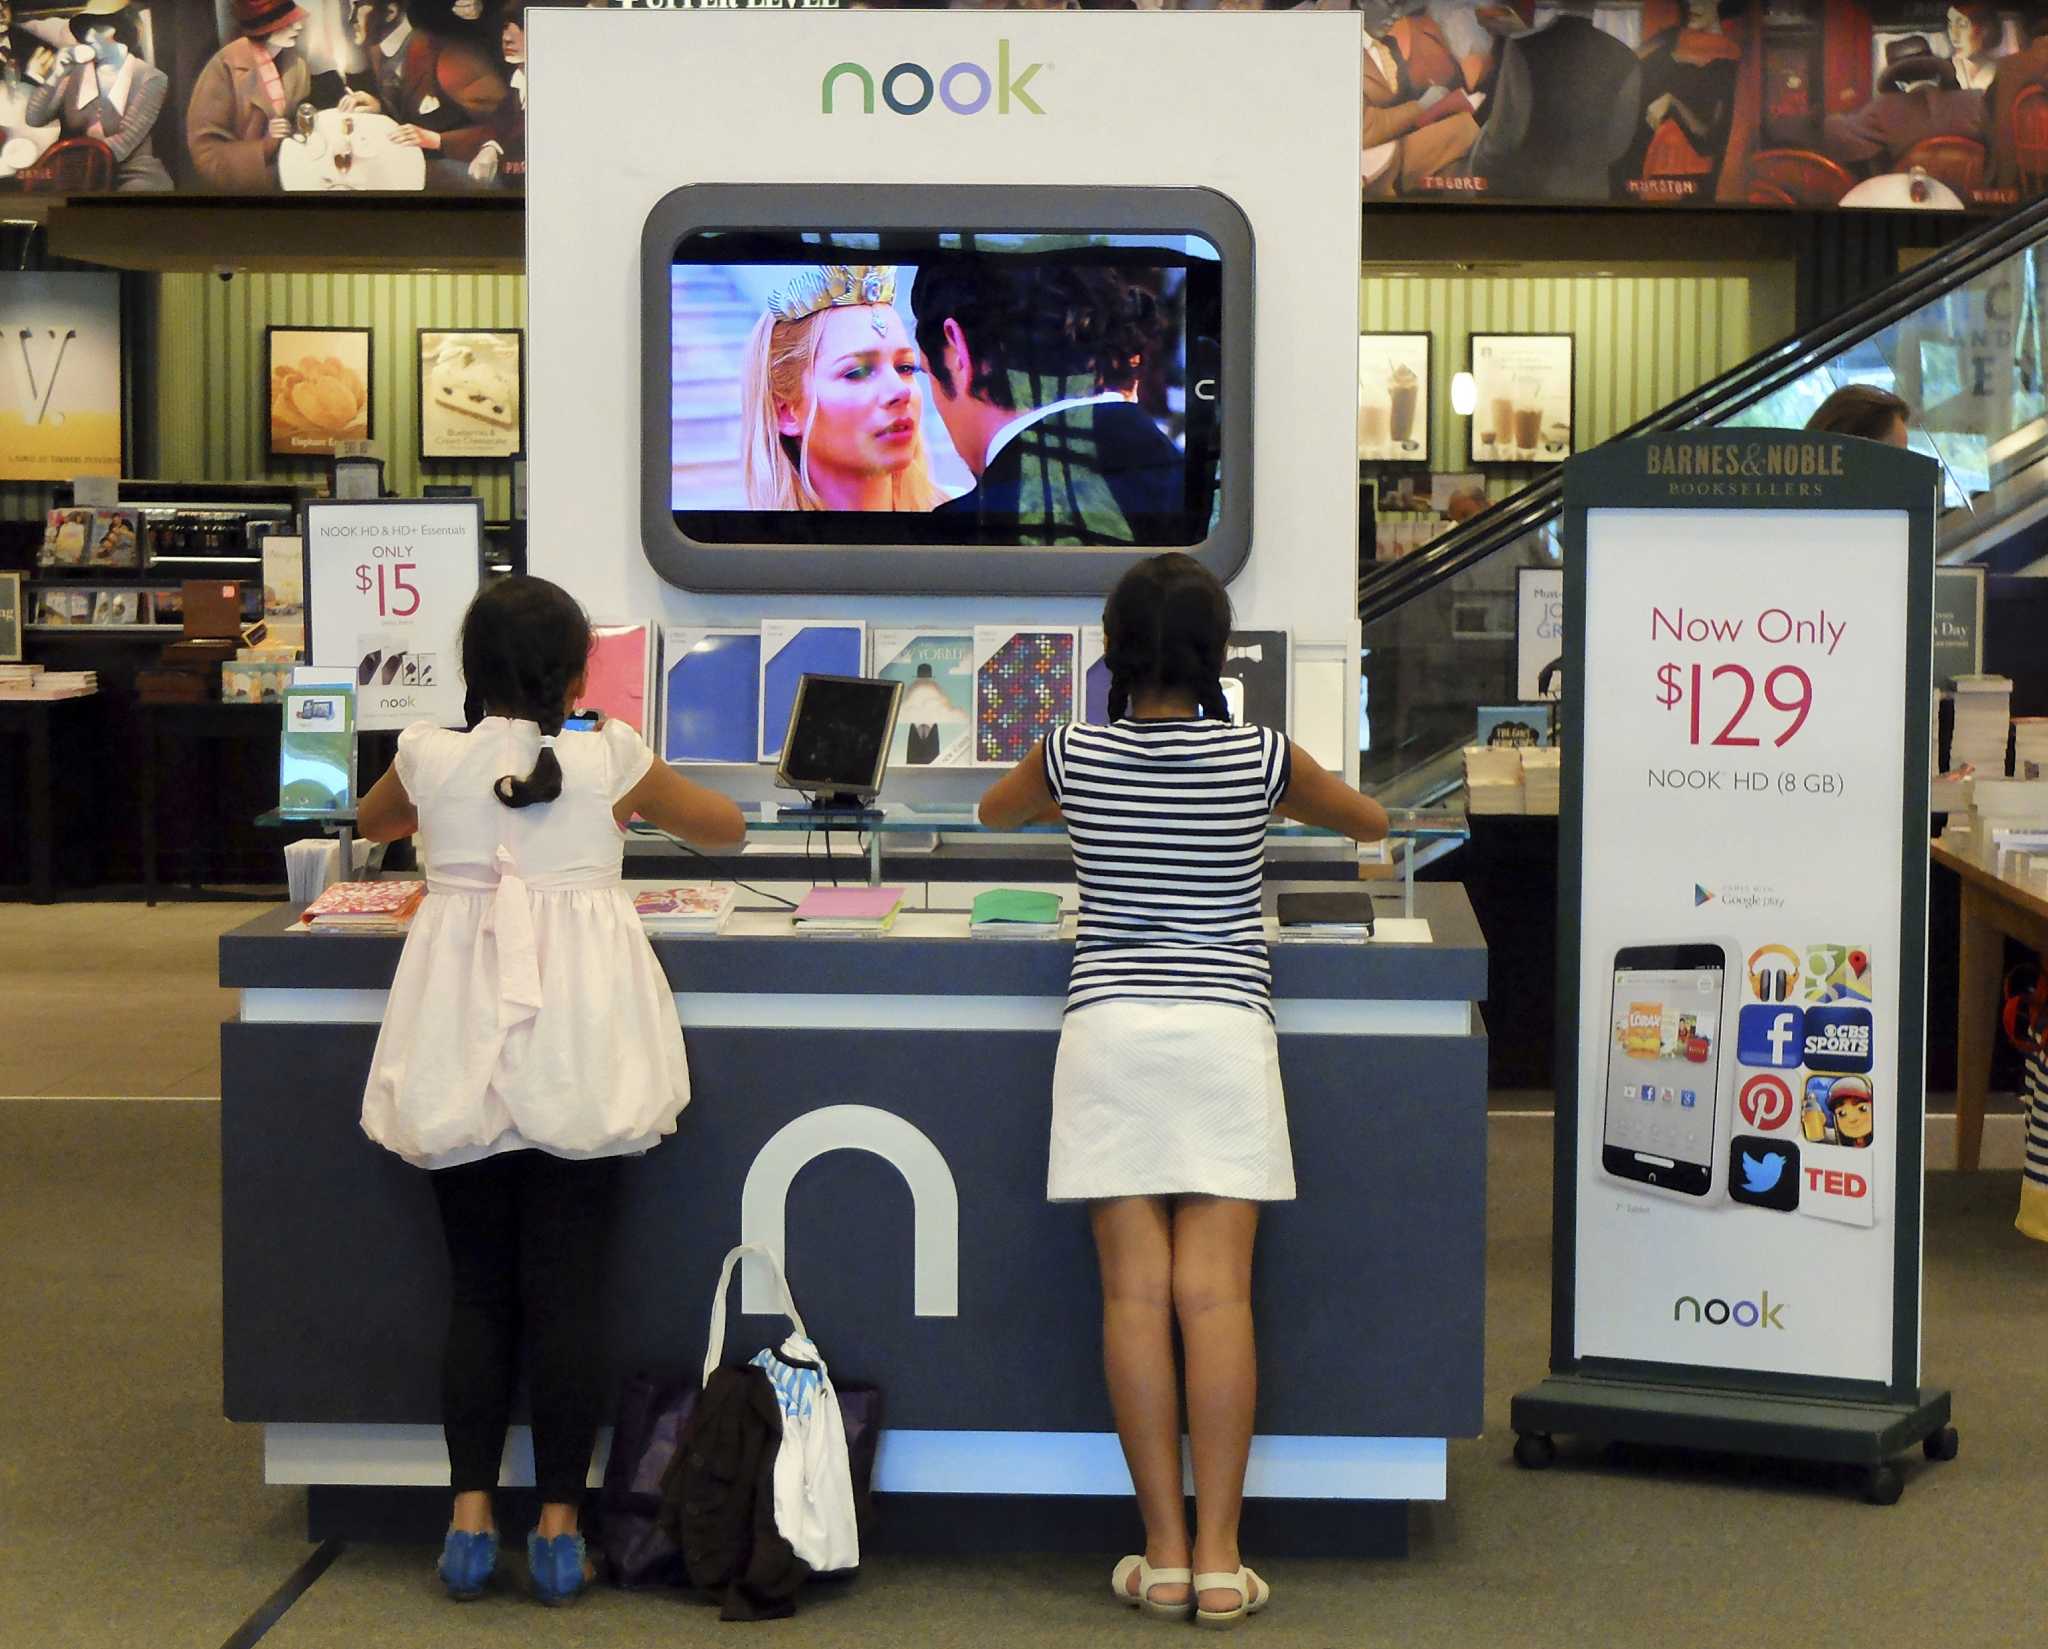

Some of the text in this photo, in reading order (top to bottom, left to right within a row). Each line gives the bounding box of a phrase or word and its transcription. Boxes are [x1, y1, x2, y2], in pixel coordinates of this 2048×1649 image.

[822, 39, 1048, 115] nook
[1668, 482, 1824, 497] BOOKSELLERS
[320, 523, 466, 537] NOOK HD & HD+ Essentials
[372, 545, 414, 559] ONLY
[355, 563, 421, 617] $15
[1652, 606, 1847, 656] Now Only
[380, 696, 416, 709] nook
[1656, 662, 1813, 748] $129
[1648, 769, 1844, 798] NOOK HD (8 GB)
[1804, 1036, 1869, 1056] SPORTS
[1837, 1025, 1869, 1039] CBS
[1804, 1167, 1868, 1199] TED
[1674, 1290, 1785, 1330] nook
